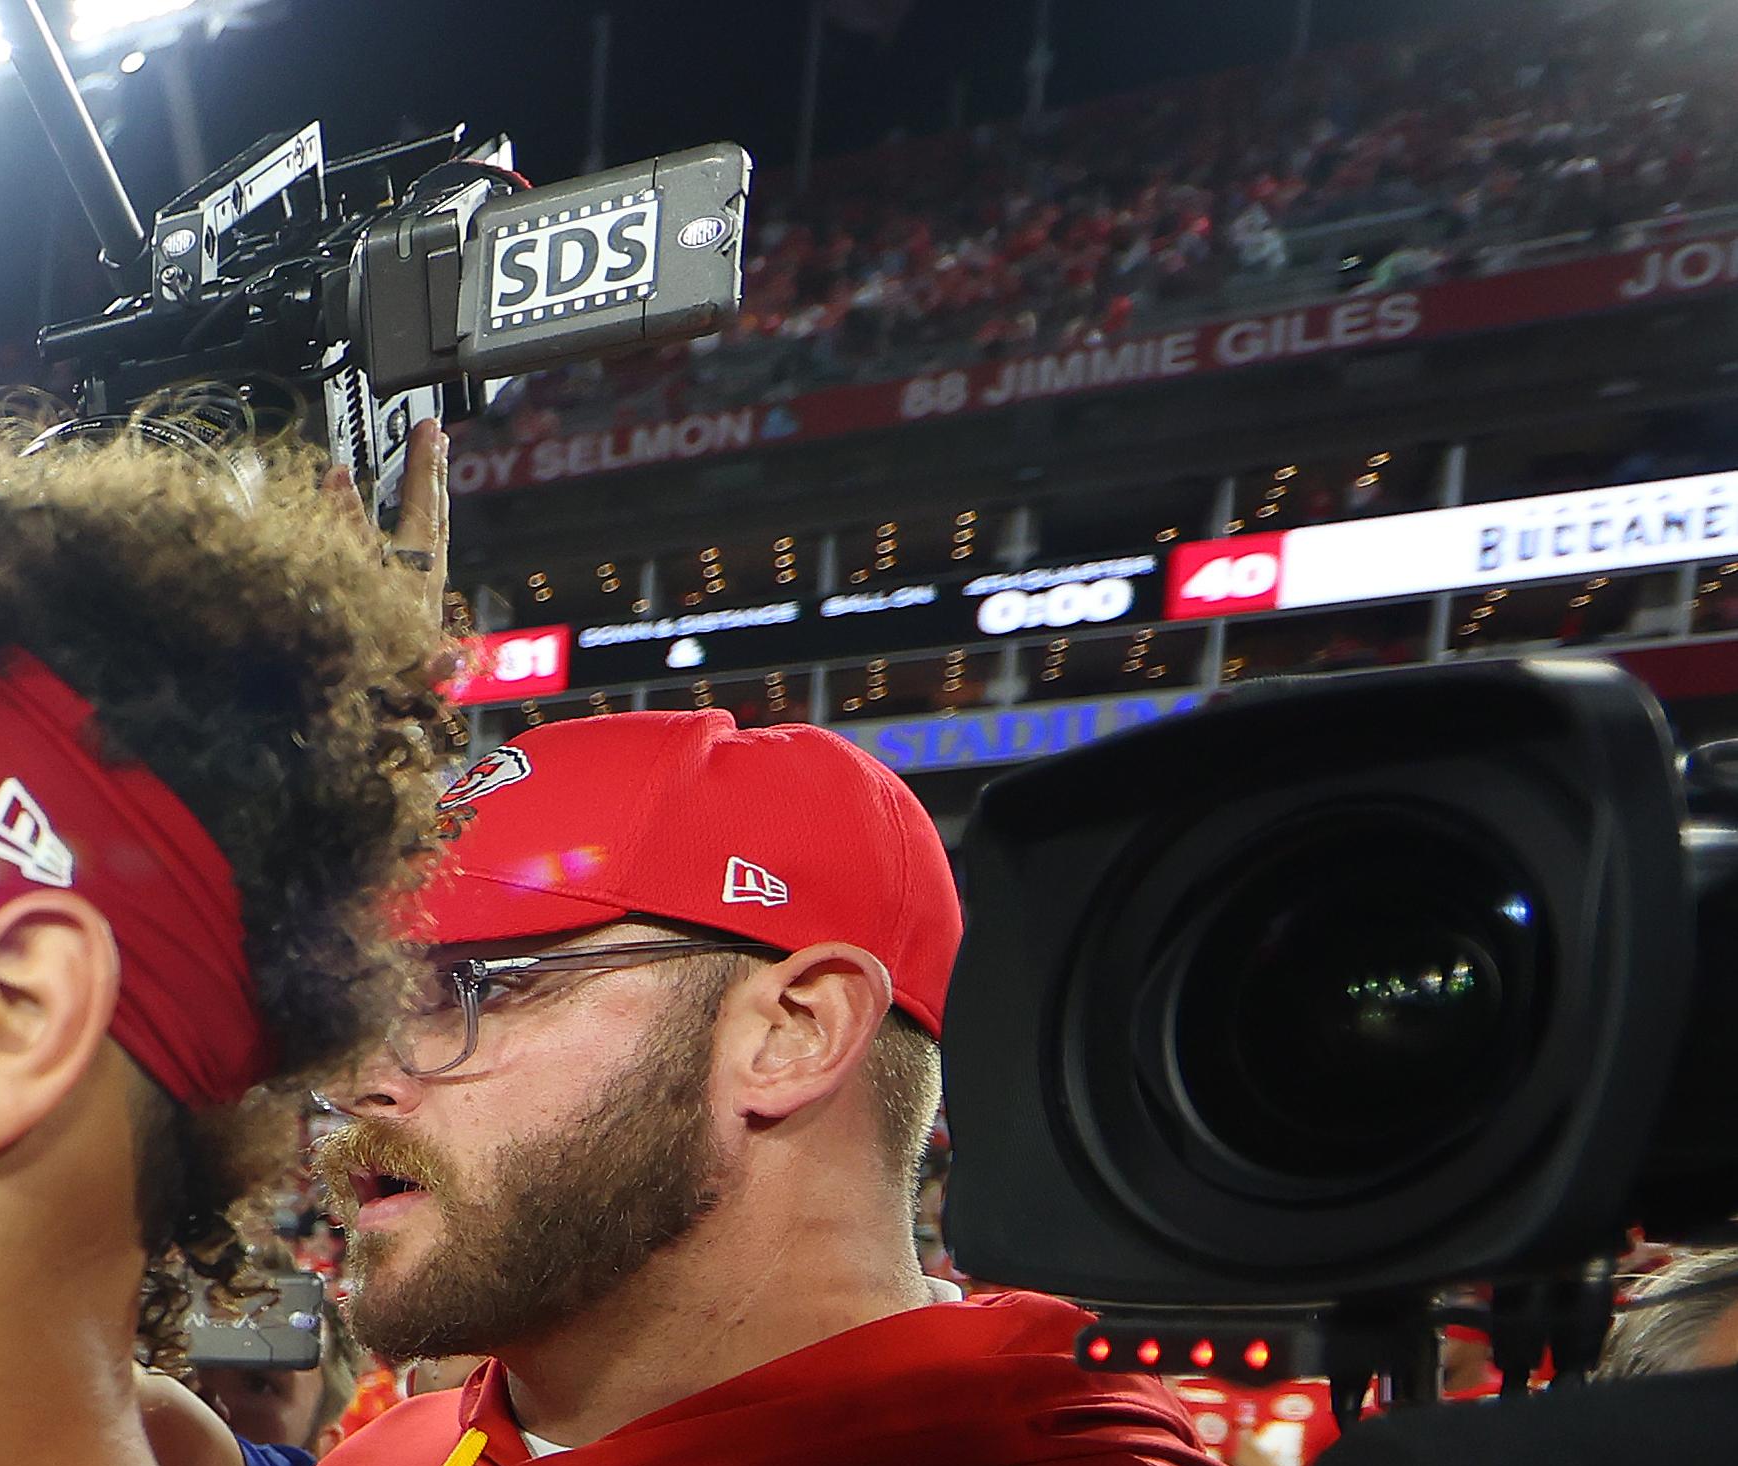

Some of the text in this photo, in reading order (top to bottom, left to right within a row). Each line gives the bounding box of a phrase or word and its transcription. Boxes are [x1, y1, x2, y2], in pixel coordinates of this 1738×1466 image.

[497, 209, 649, 309] SDS
[680, 220, 725, 245] ARRI
[1620, 237, 1738, 297] JO
[982, 328, 1201, 406] JIMMIE
[1215, 293, 1422, 366] GILES
[530, 406, 756, 483] SELMON
[977, 575, 1134, 635] 0:00
[1181, 552, 1278, 602] 40
